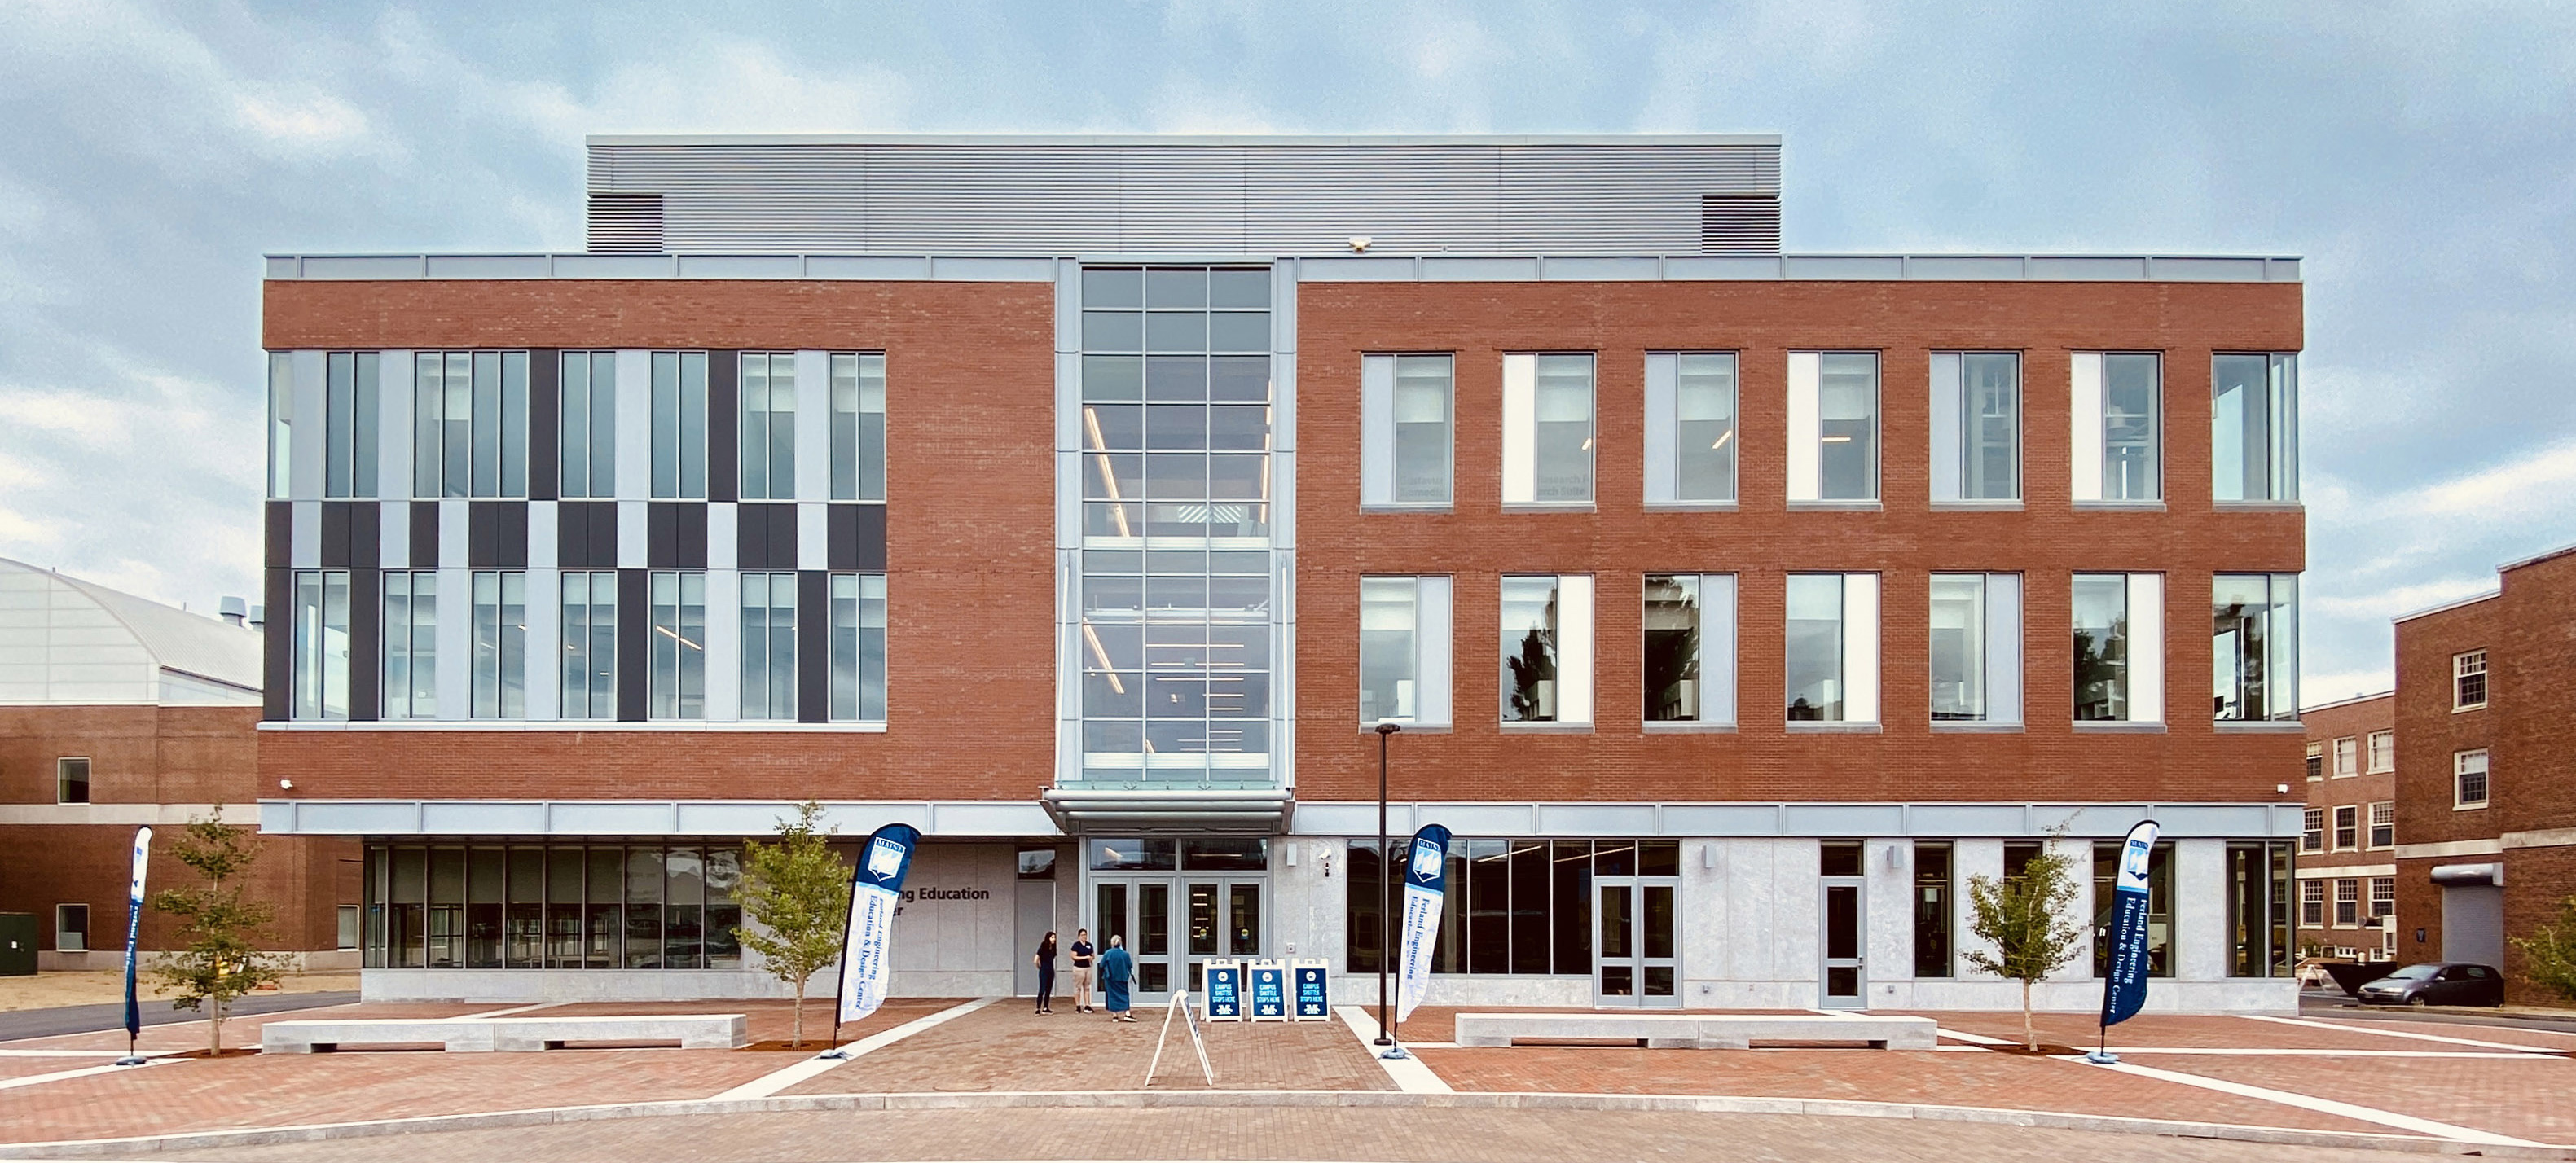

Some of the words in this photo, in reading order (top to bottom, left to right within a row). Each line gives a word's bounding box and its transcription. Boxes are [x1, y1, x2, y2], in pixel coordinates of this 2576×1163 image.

[1400, 488, 1444, 497] Biomedic
[1538, 474, 1580, 484] esearch
[1419, 840, 1440, 852] MAIN
[2130, 840, 2148, 849] MAIN
[919, 887, 989, 899] Education
[865, 895, 877, 937] Education
[1408, 896, 1418, 937] Educati
[1418, 898, 1430, 928] Ferland
[2121, 897, 2136, 940] Education
[864, 939, 871, 948] &
[1408, 930, 1422, 979] Engineering
[2119, 942, 2126, 950] &
[2113, 954, 2125, 982] Design
[2123, 933, 2144, 984] Engineering
[855, 981, 866, 1009] Center
[2110, 985, 2120, 1013] Center
